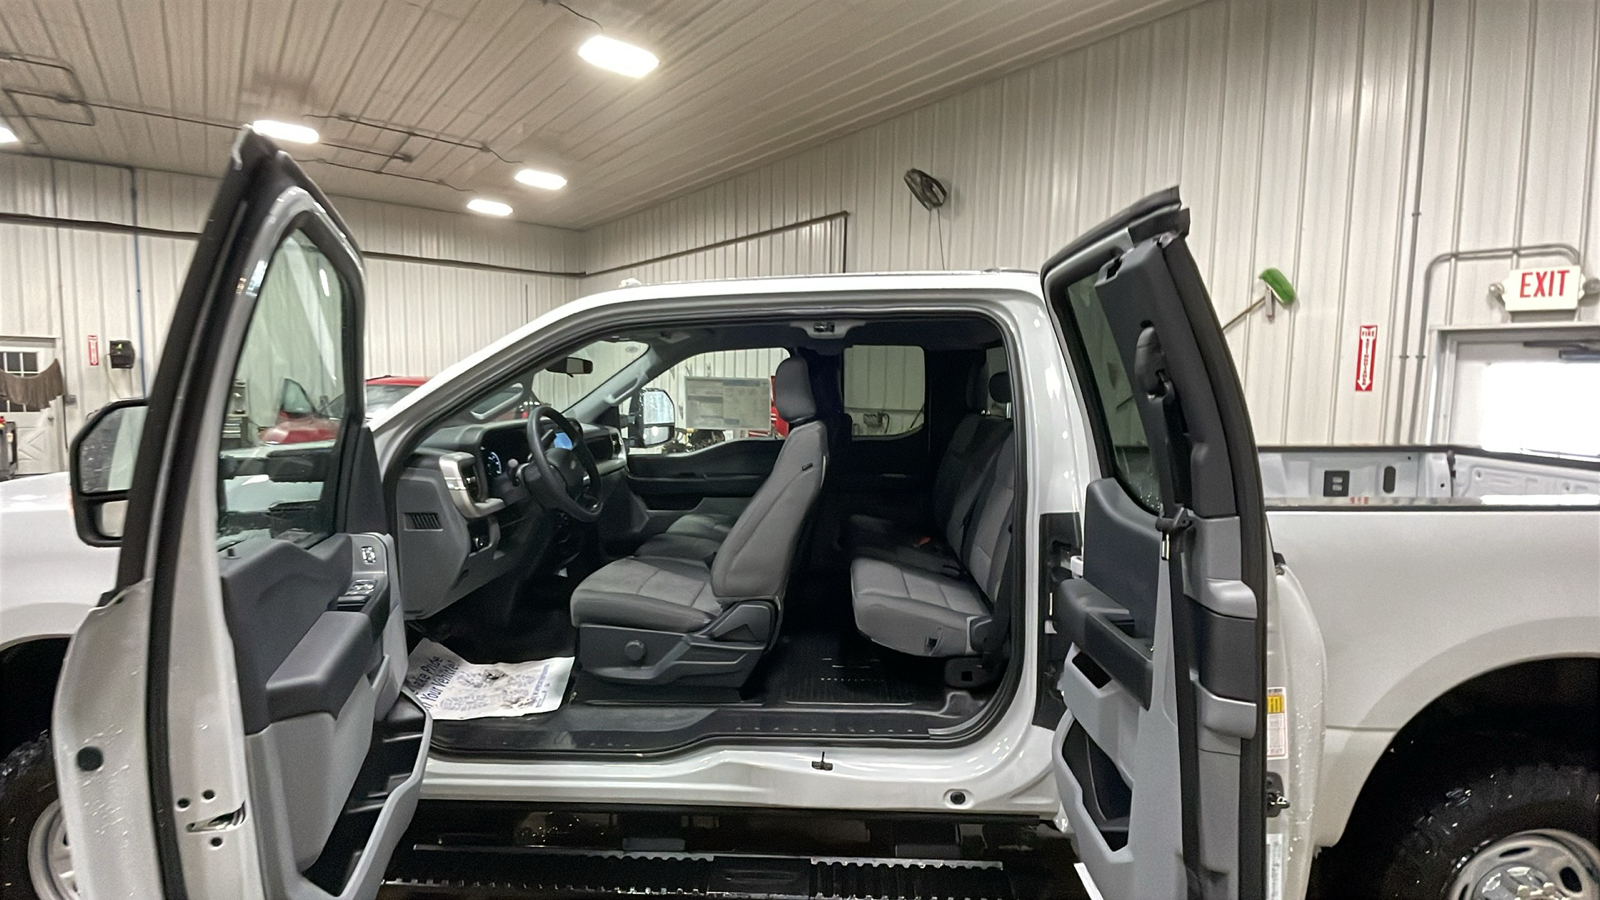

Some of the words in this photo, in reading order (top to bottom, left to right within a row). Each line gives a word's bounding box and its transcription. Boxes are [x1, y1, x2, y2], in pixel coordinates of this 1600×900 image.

[1519, 269, 1570, 298] EXIT
[420, 656, 443, 675] Pride
[420, 686, 444, 702] Your
